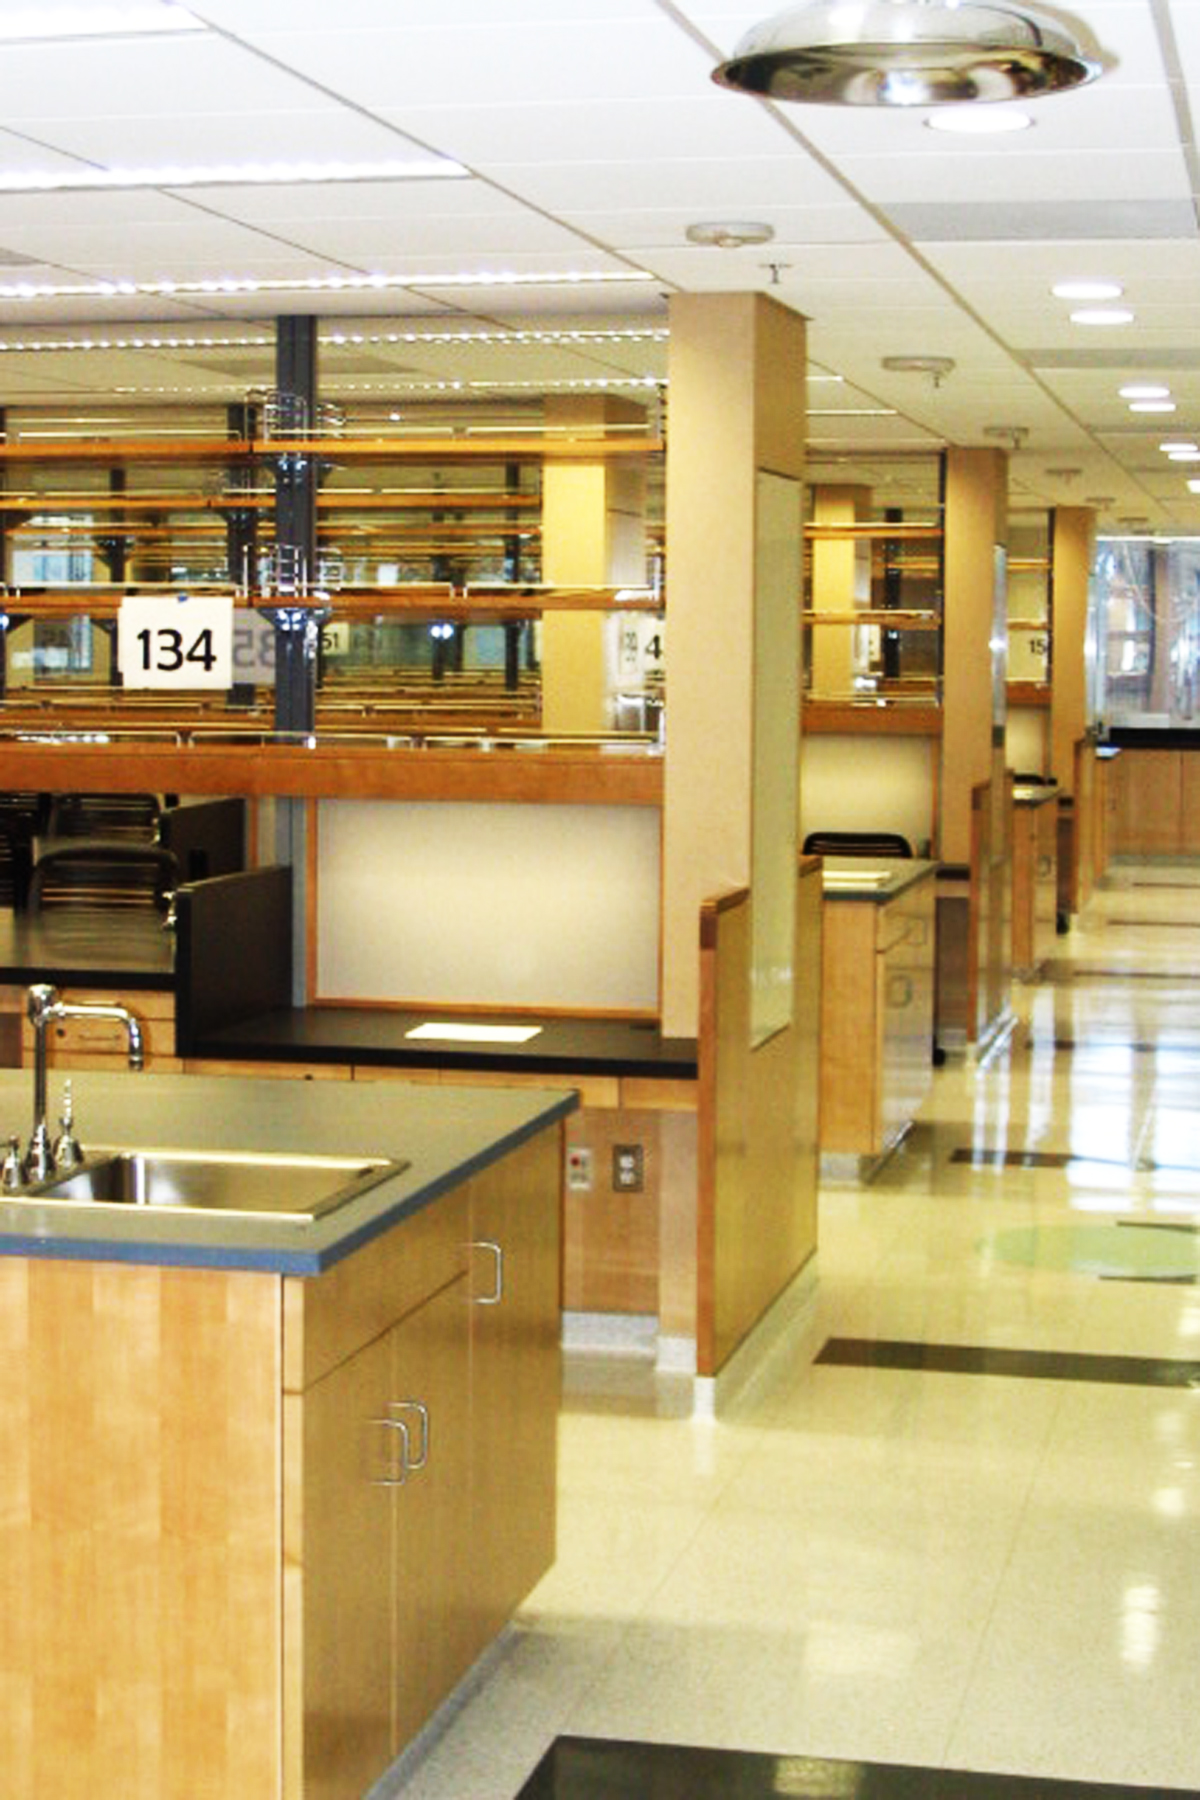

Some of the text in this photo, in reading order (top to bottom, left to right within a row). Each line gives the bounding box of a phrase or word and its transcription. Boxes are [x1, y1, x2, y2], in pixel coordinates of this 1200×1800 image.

[322, 632, 338, 650] 51
[1028, 638, 1047, 656] 15
[137, 629, 216, 672] 134
